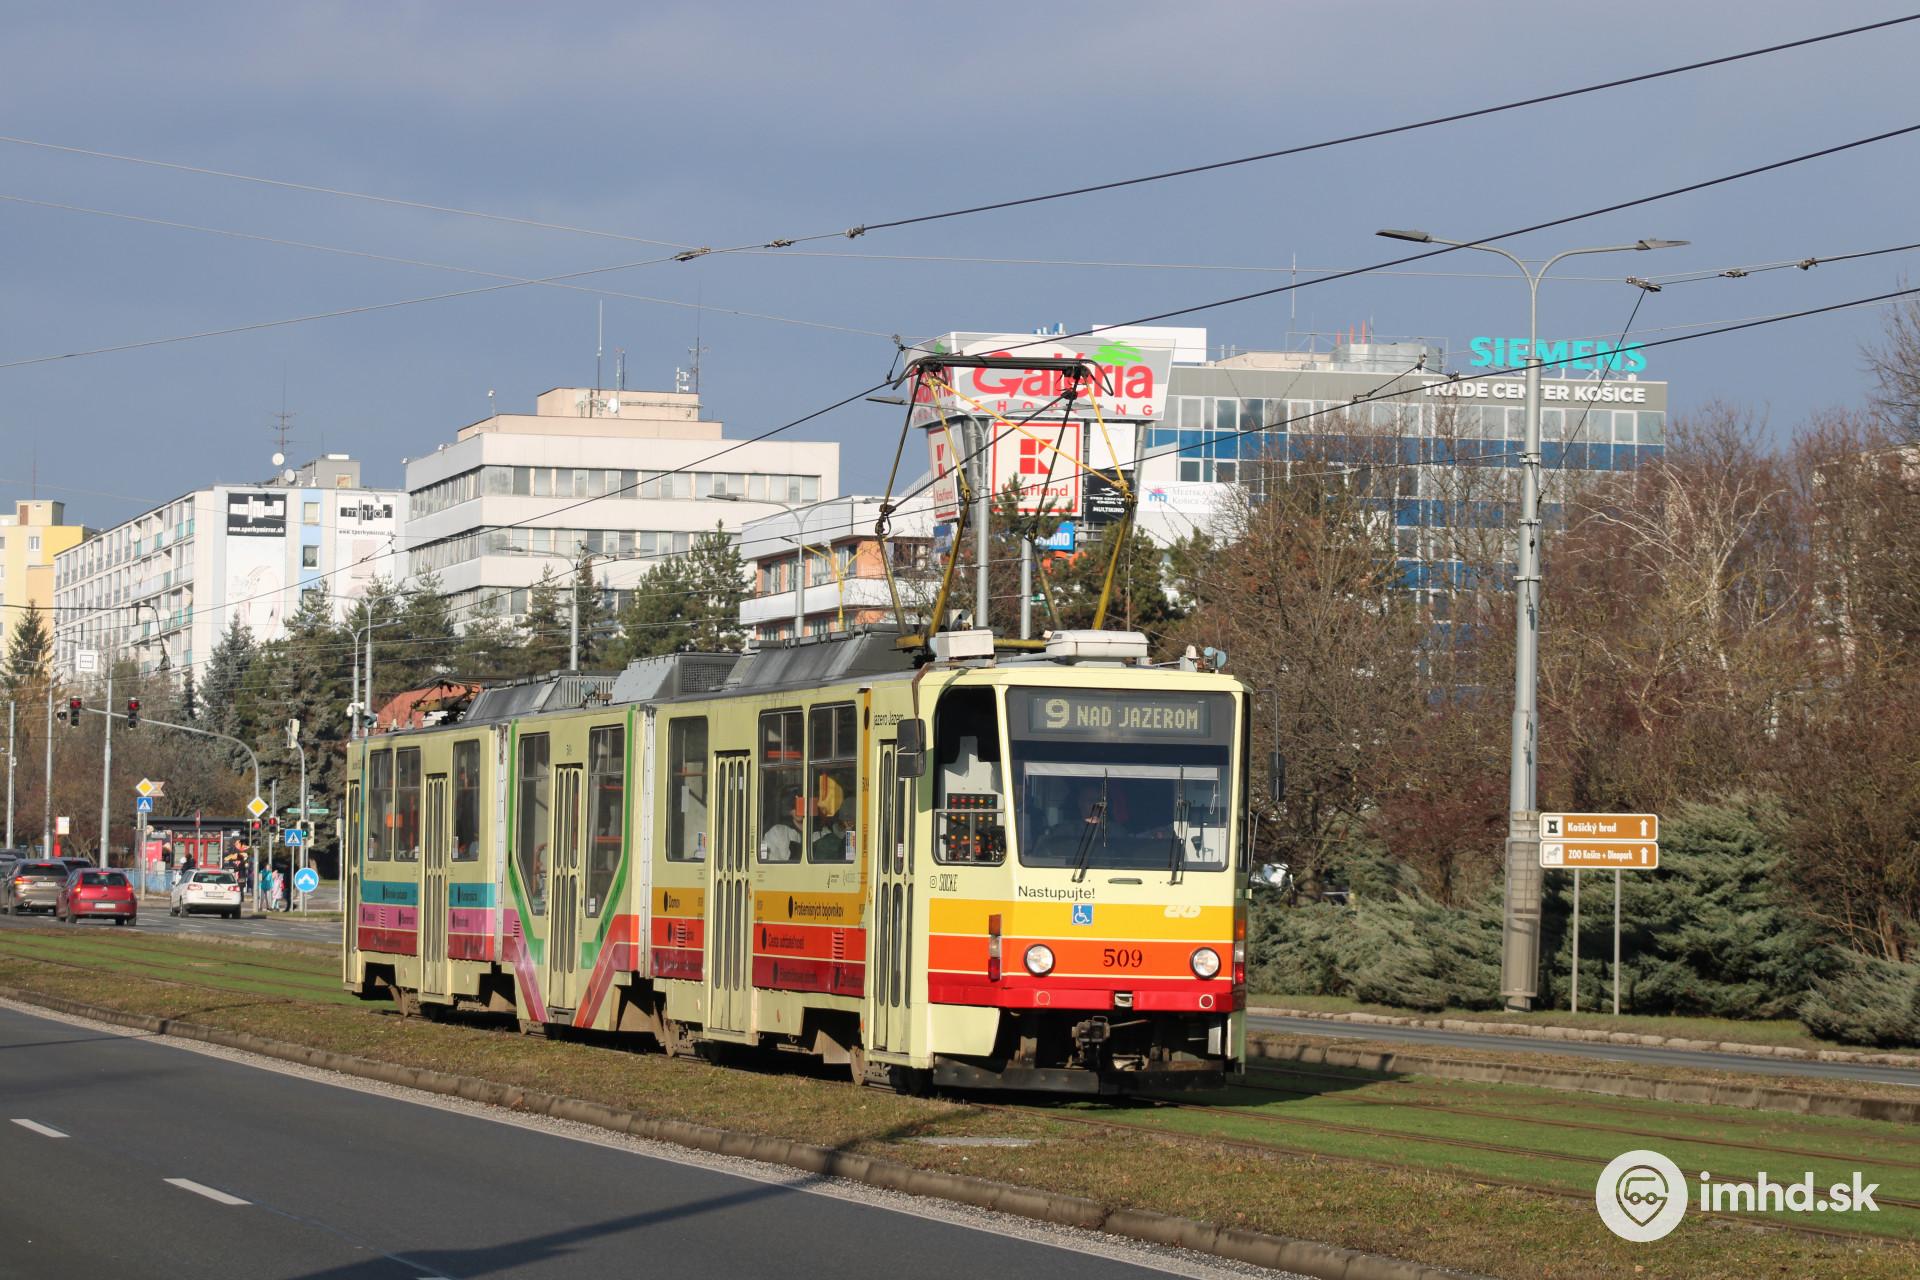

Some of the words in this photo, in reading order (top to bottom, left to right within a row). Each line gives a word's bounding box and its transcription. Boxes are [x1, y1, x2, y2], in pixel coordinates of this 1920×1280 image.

[1470, 336, 1647, 373] SIEMENS
[1422, 380, 1489, 399] TRADE
[1574, 382, 1646, 402] KOŠICE
[1002, 484, 1068, 496] Kufland
[1046, 698, 1070, 729] 9
[1077, 705, 1112, 727] NAD
[1118, 706, 1199, 730] JAZEROM
[1599, 821, 1617, 833] hrad
[1568, 849, 1582, 860] ZOO
[1018, 885, 1096, 901] Nastupujte!
[1102, 948, 1143, 969] 509
